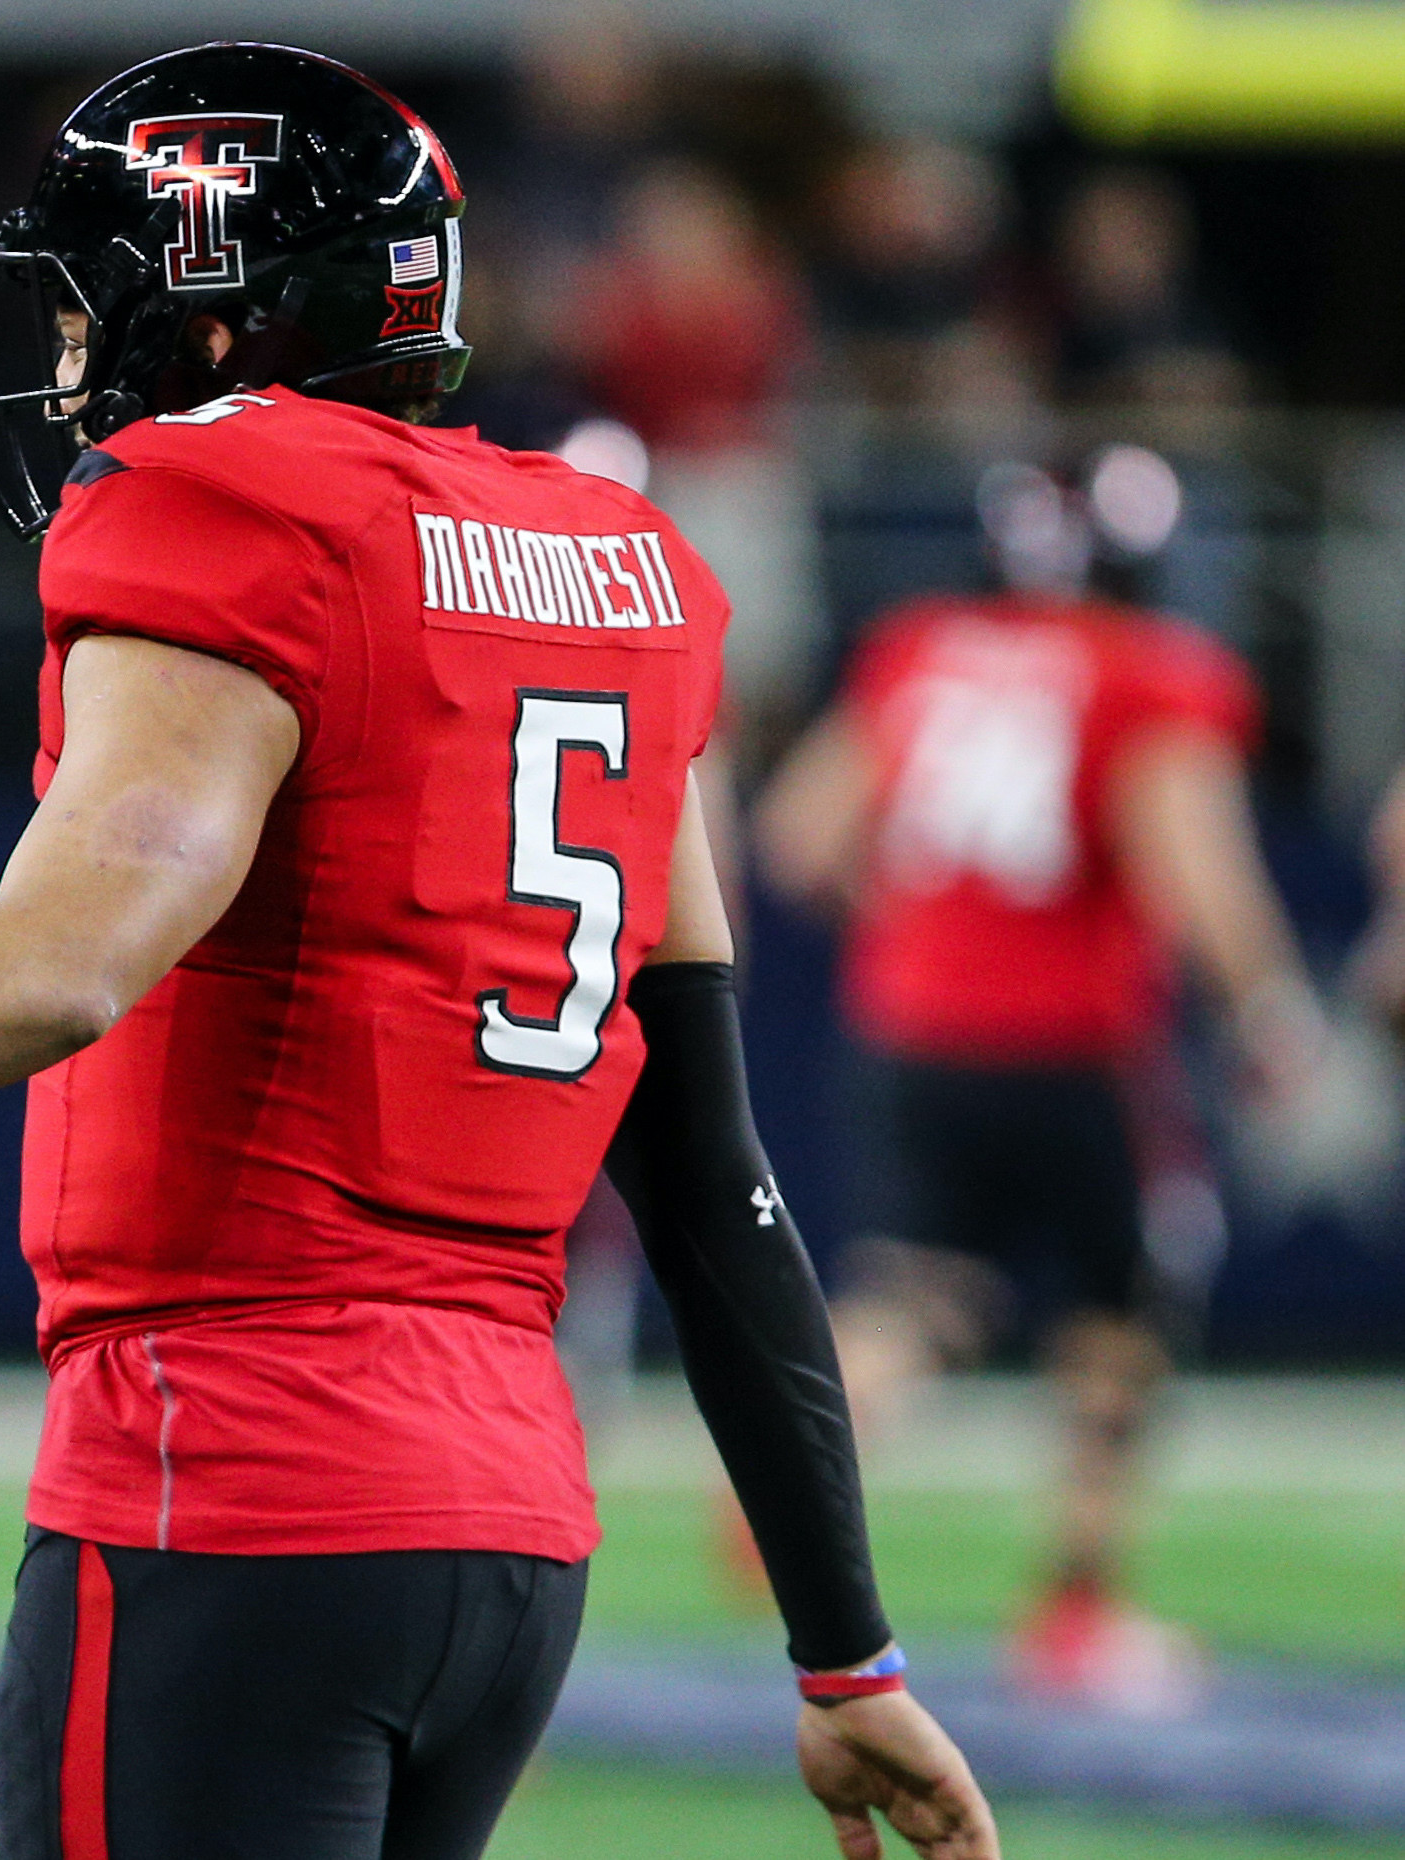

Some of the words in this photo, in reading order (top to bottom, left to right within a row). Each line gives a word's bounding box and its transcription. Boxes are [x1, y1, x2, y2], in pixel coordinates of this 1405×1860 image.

[385, 286, 440, 333] XII
[414, 512, 652, 629] MAHOMES
[472, 686, 631, 1083] 5
